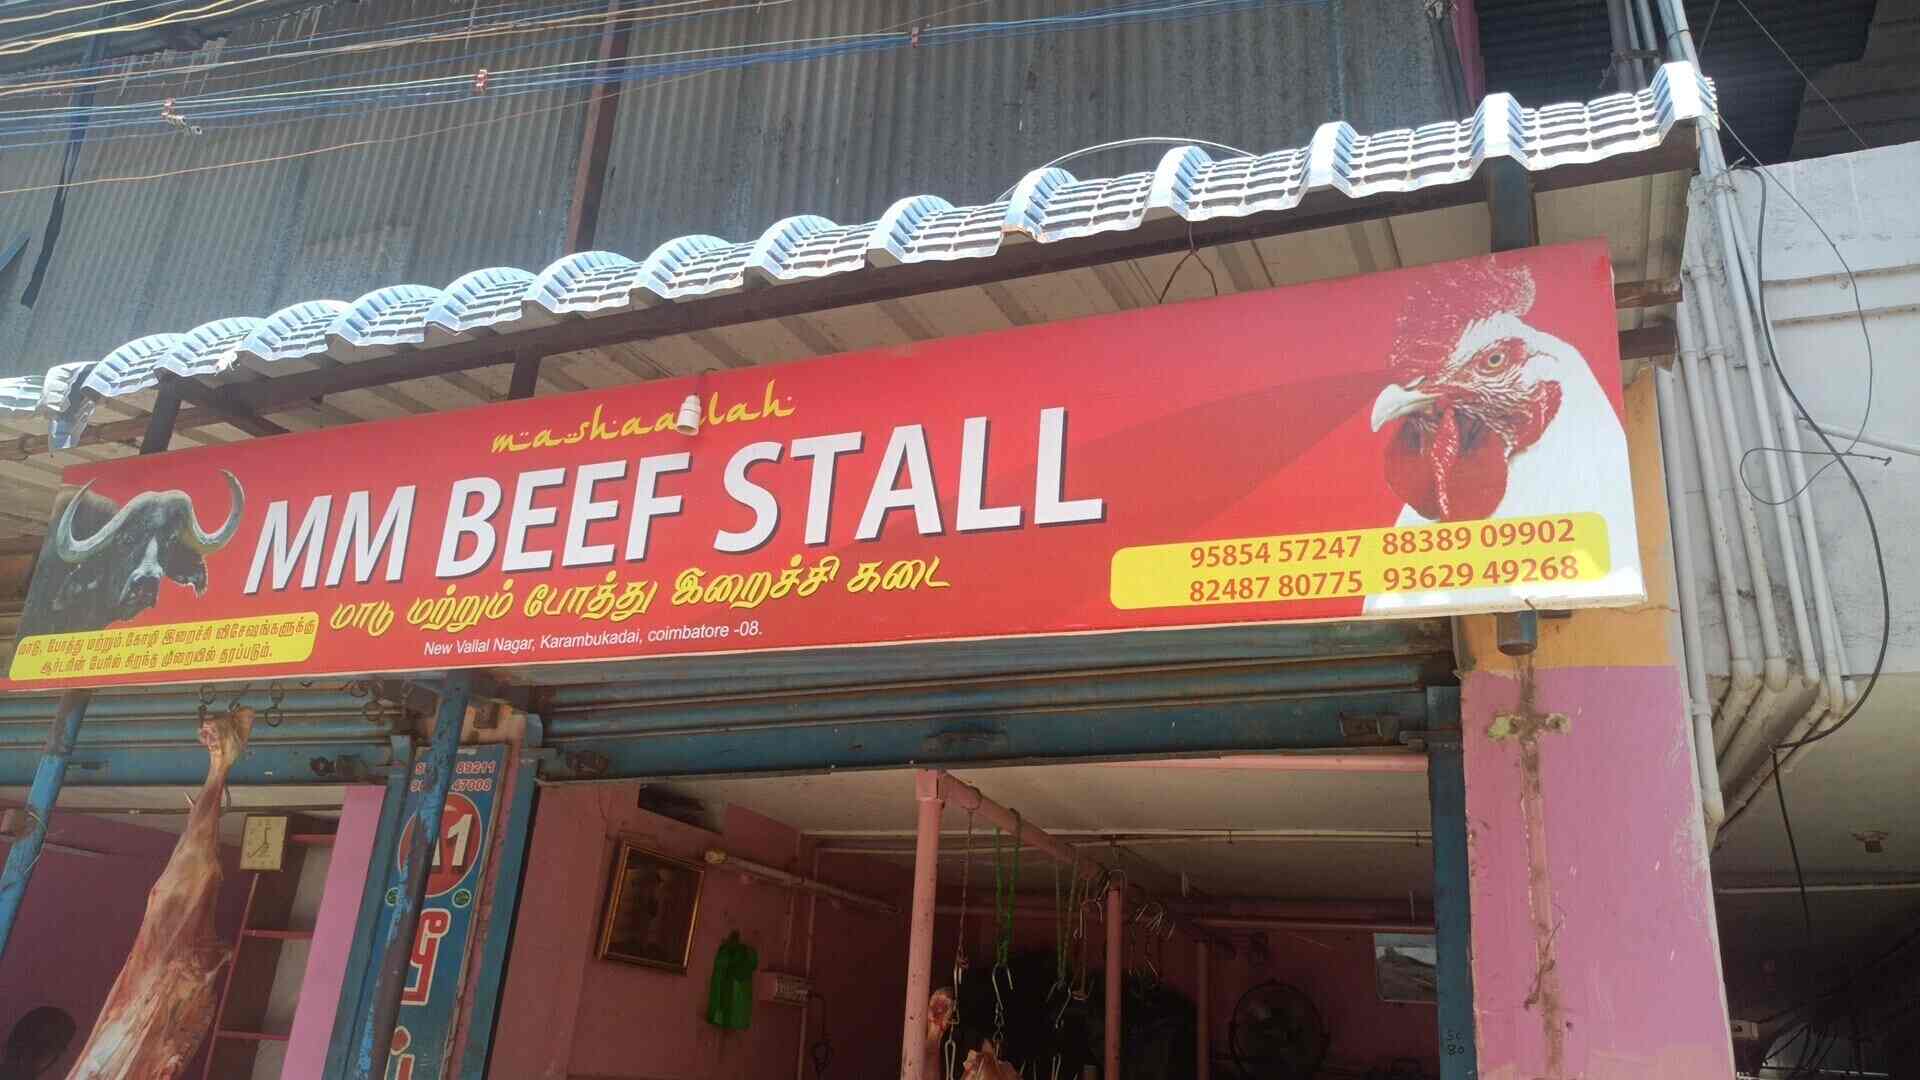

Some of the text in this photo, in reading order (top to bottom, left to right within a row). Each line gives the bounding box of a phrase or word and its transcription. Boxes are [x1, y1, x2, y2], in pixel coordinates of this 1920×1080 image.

[491, 379, 795, 453] mashaalah
[244, 406, 1105, 595] MM BEEF STALL
[1190, 535, 1361, 568] 95854 57247
[1382, 518, 1575, 555] 88389 09902
[1189, 570, 1363, 602] 82487 80775
[1383, 555, 1578, 593] 93629 49268
[329, 554, 952, 637] மாடு மற்றும் போத்து இறைச்சி கடை
[424, 620, 764, 656] New Vallal Nagar, Karambukadai, coimbatore -08.
